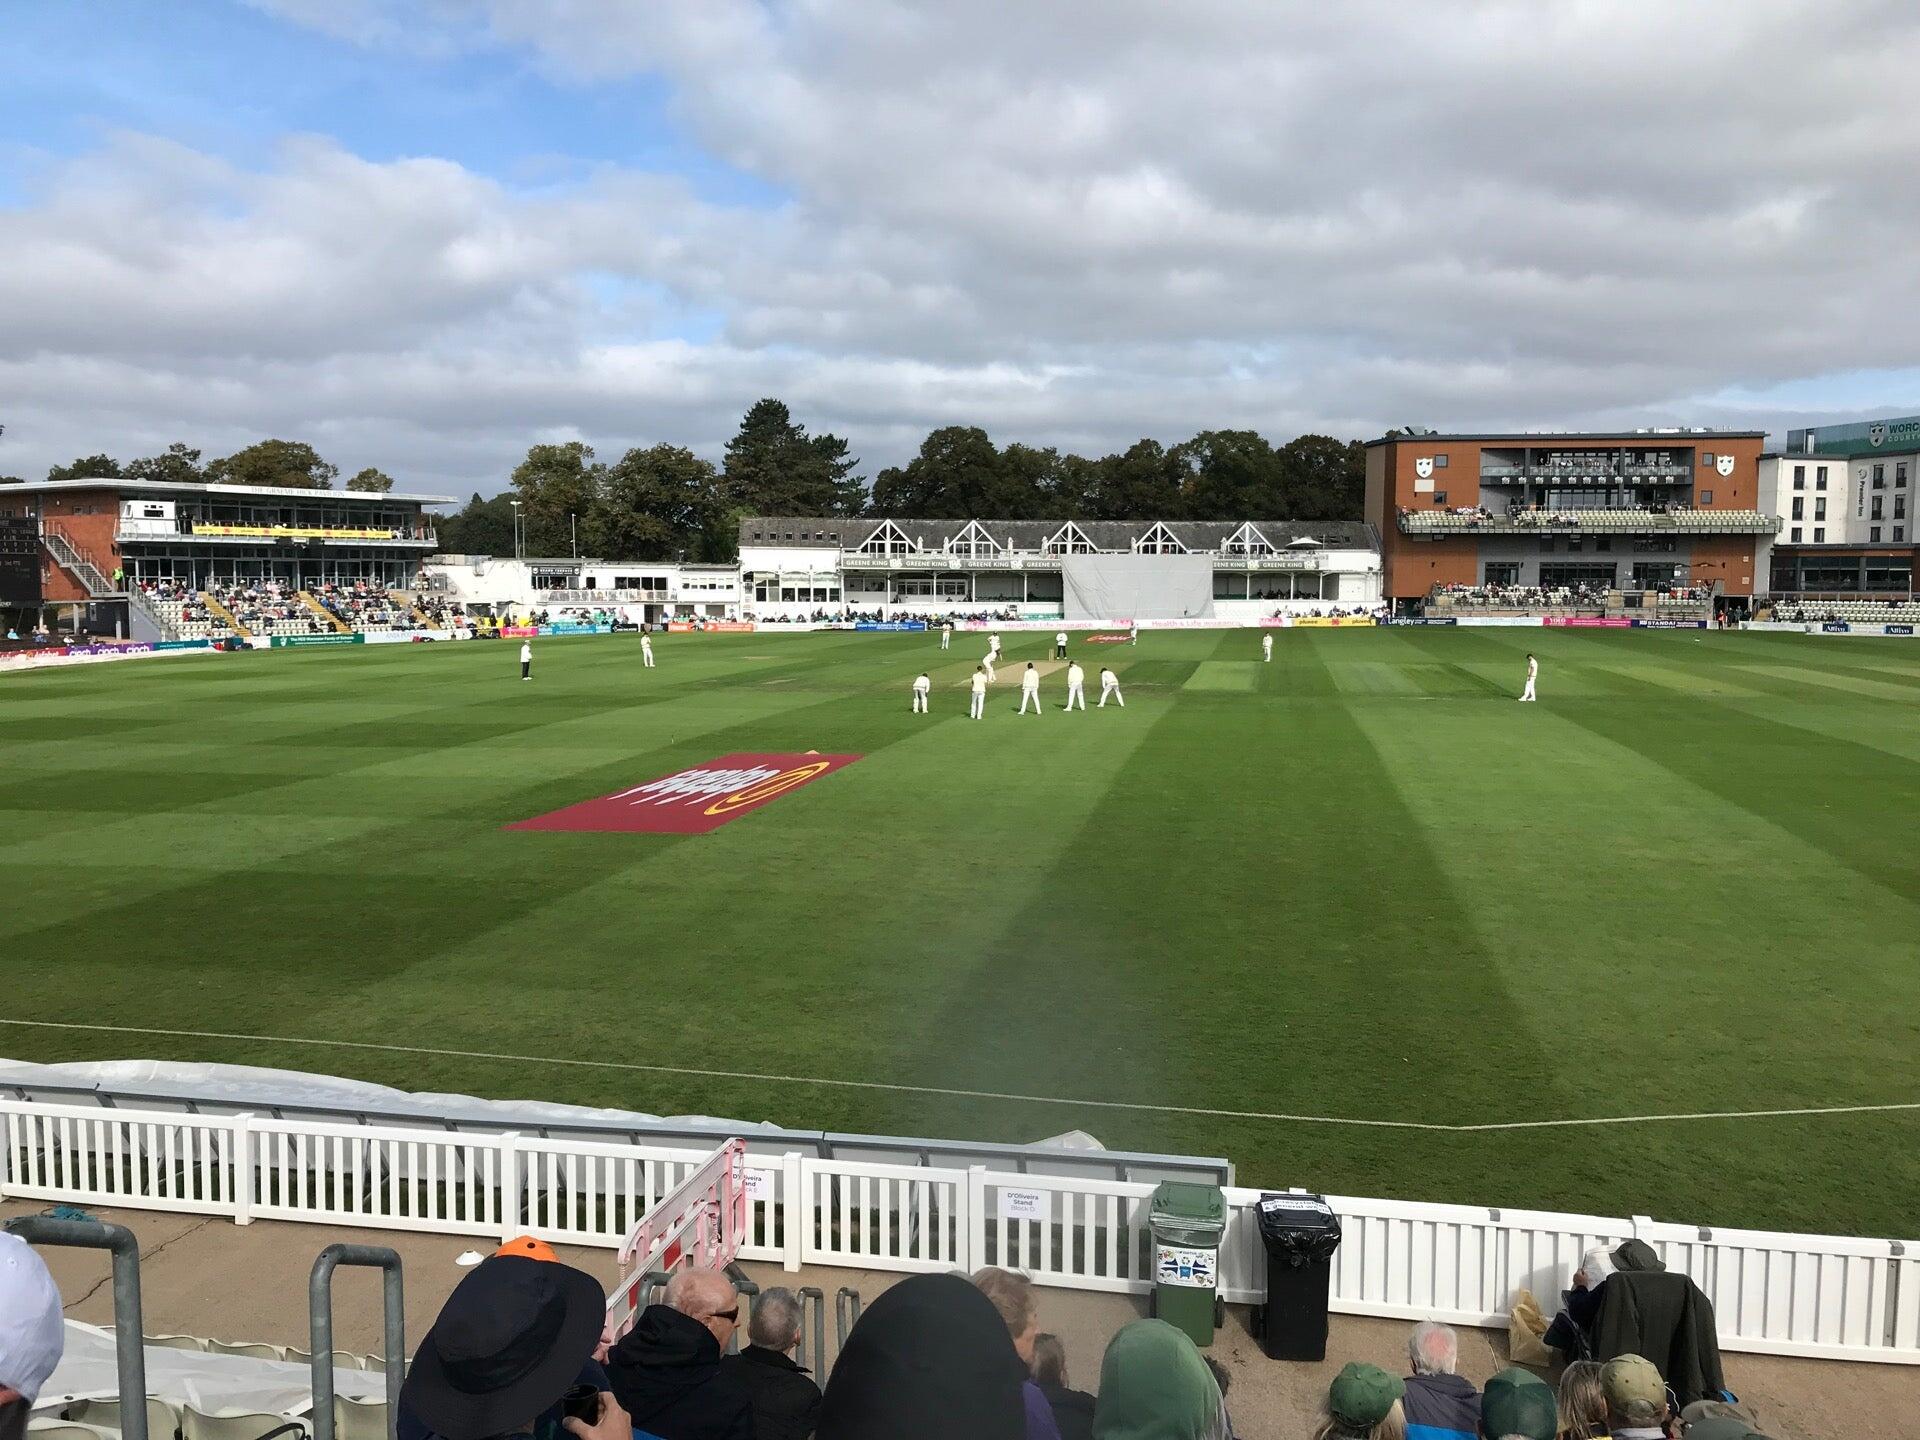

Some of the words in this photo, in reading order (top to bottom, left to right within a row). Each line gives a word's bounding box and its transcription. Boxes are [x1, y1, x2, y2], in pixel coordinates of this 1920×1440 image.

[1889, 422, 1920, 434] WORC
[1388, 617, 1415, 626] Langley
[97, 647, 119, 655] cinch
[126, 645, 150, 654] cinch
